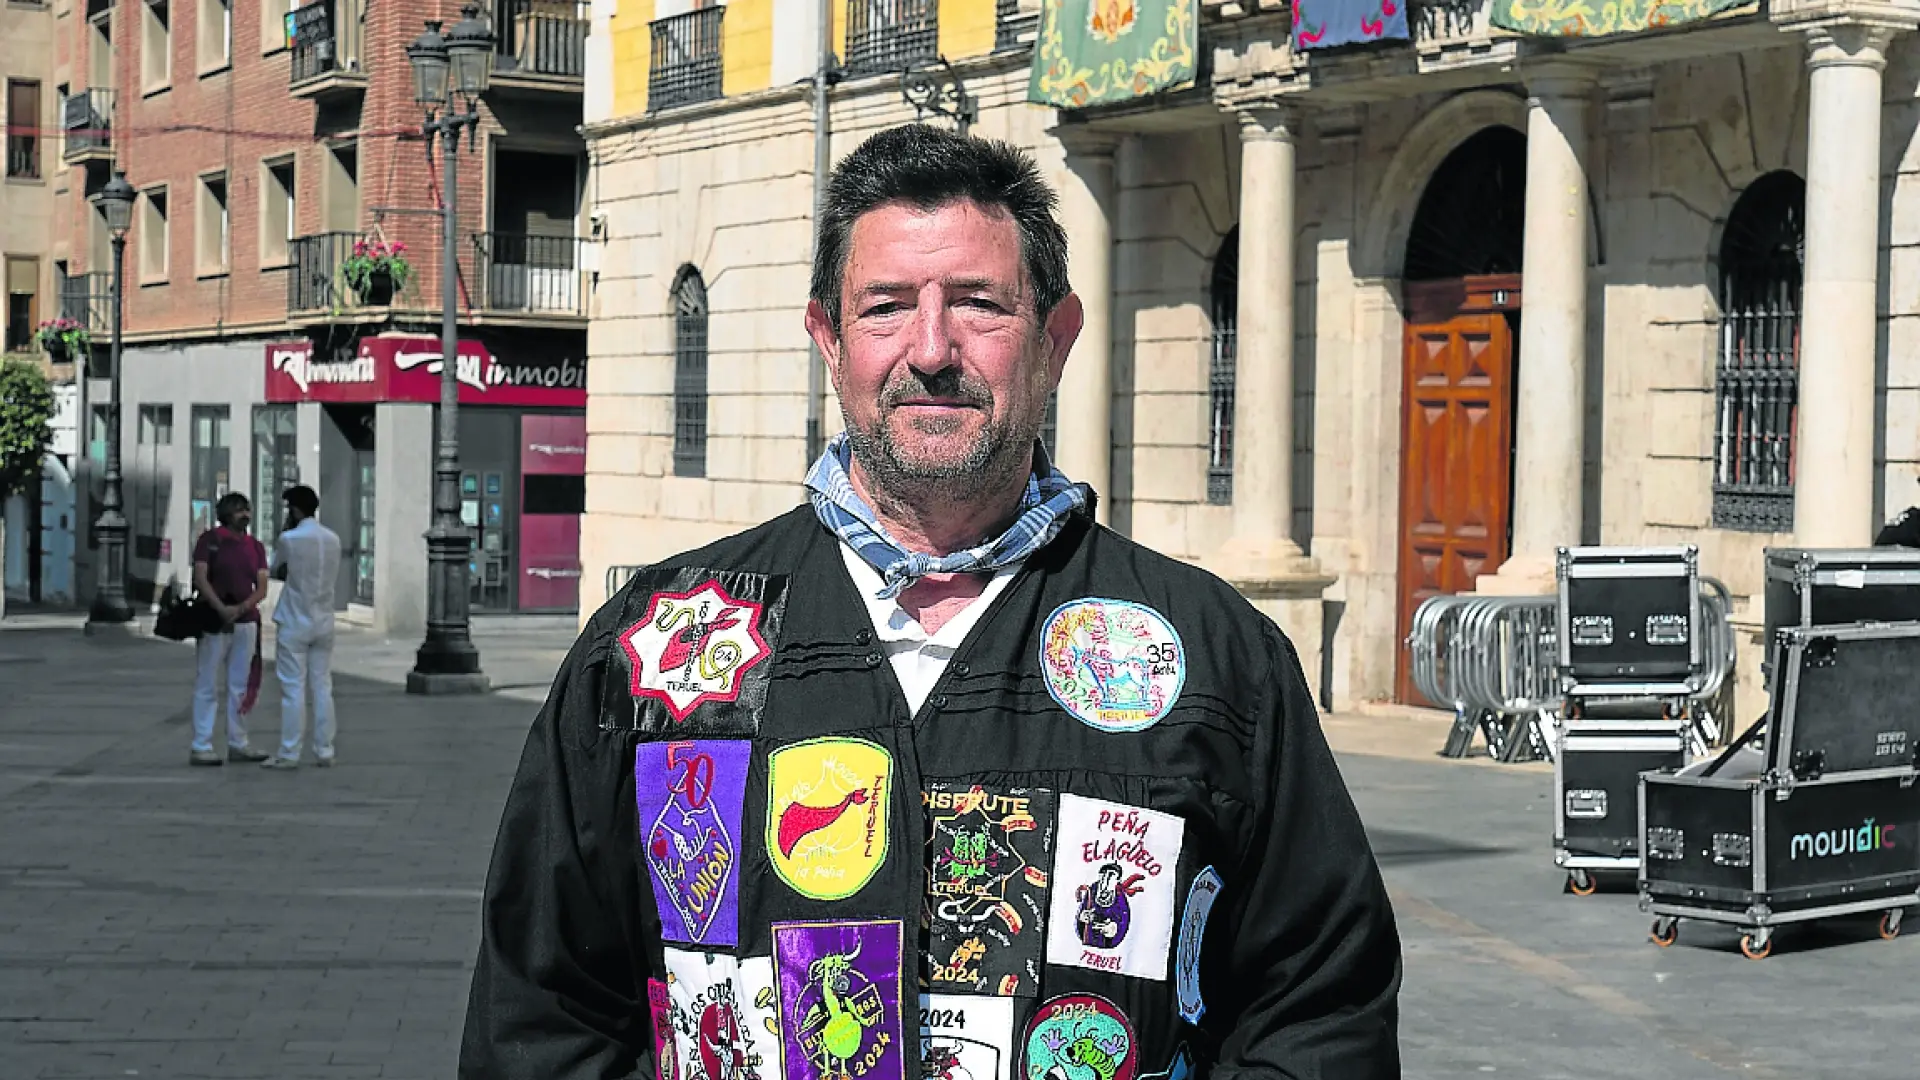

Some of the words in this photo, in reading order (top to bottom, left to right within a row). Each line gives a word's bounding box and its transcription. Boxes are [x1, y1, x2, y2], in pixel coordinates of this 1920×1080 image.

[715, 650, 733, 663] 24
[1147, 642, 1174, 663] 35
[666, 680, 704, 693] TERUEL
[666, 741, 715, 808] 50
[864, 774, 885, 858] TERUEL
[1097, 808, 1151, 839] PEÑA
[668, 858, 686, 880] LA
[686, 841, 730, 914] UNIÓN
[1080, 949, 1122, 971] TERUEL
[931, 965, 979, 984] 2024
[919, 1007, 966, 1030] 2024
[1051, 1002, 1099, 1021] 2024
[854, 1031, 891, 1076] 2024
